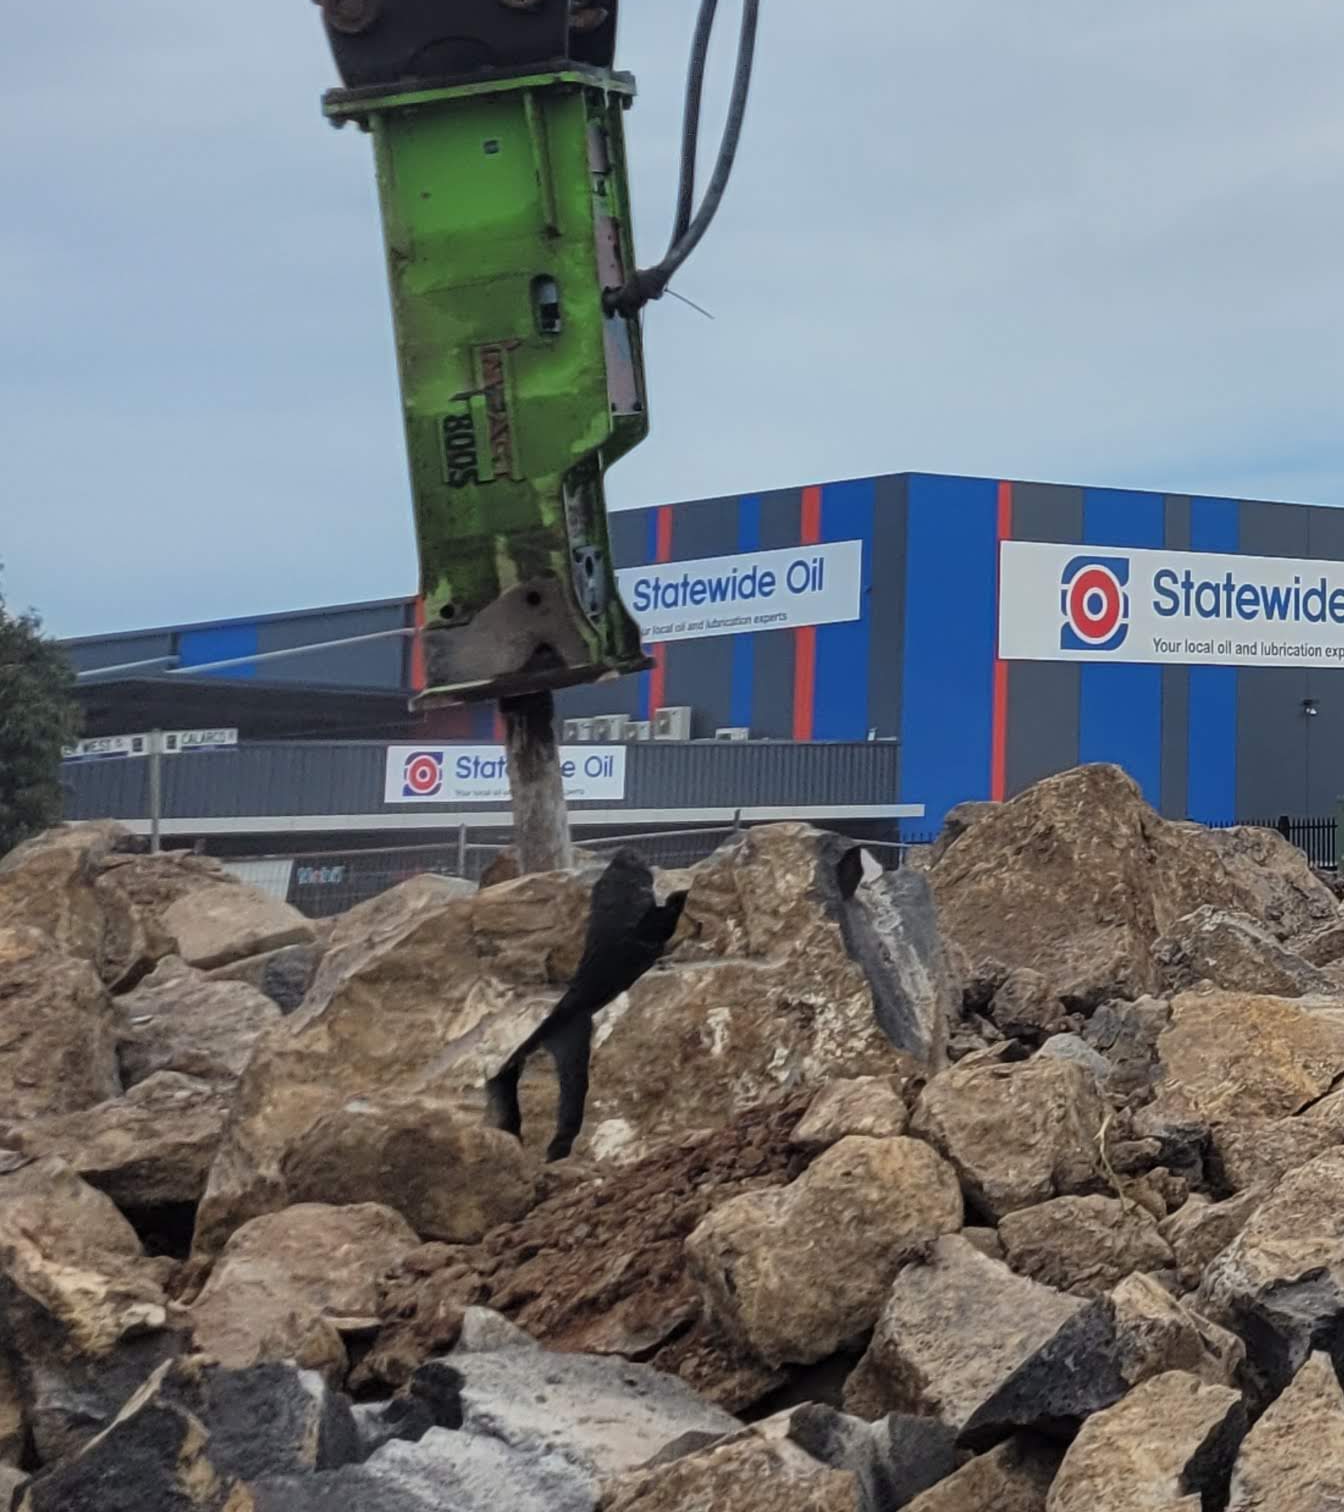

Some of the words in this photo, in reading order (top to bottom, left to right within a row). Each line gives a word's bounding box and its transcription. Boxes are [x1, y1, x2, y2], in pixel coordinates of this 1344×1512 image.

[632, 565, 776, 612] Statewide
[786, 557, 825, 594] Oil
[652, 622, 673, 635] local
[674, 621, 686, 633] oil
[687, 620, 704, 631] and
[705, 615, 752, 630] lubrication
[753, 611, 788, 626] experts
[1152, 638, 1182, 654] Your
[1184, 639, 1214, 655] local
[1217, 640, 1232, 656] oil
[1235, 641, 1258, 656] and
[1260, 641, 1323, 659] lubrication
[584, 755, 615, 778] Oil
